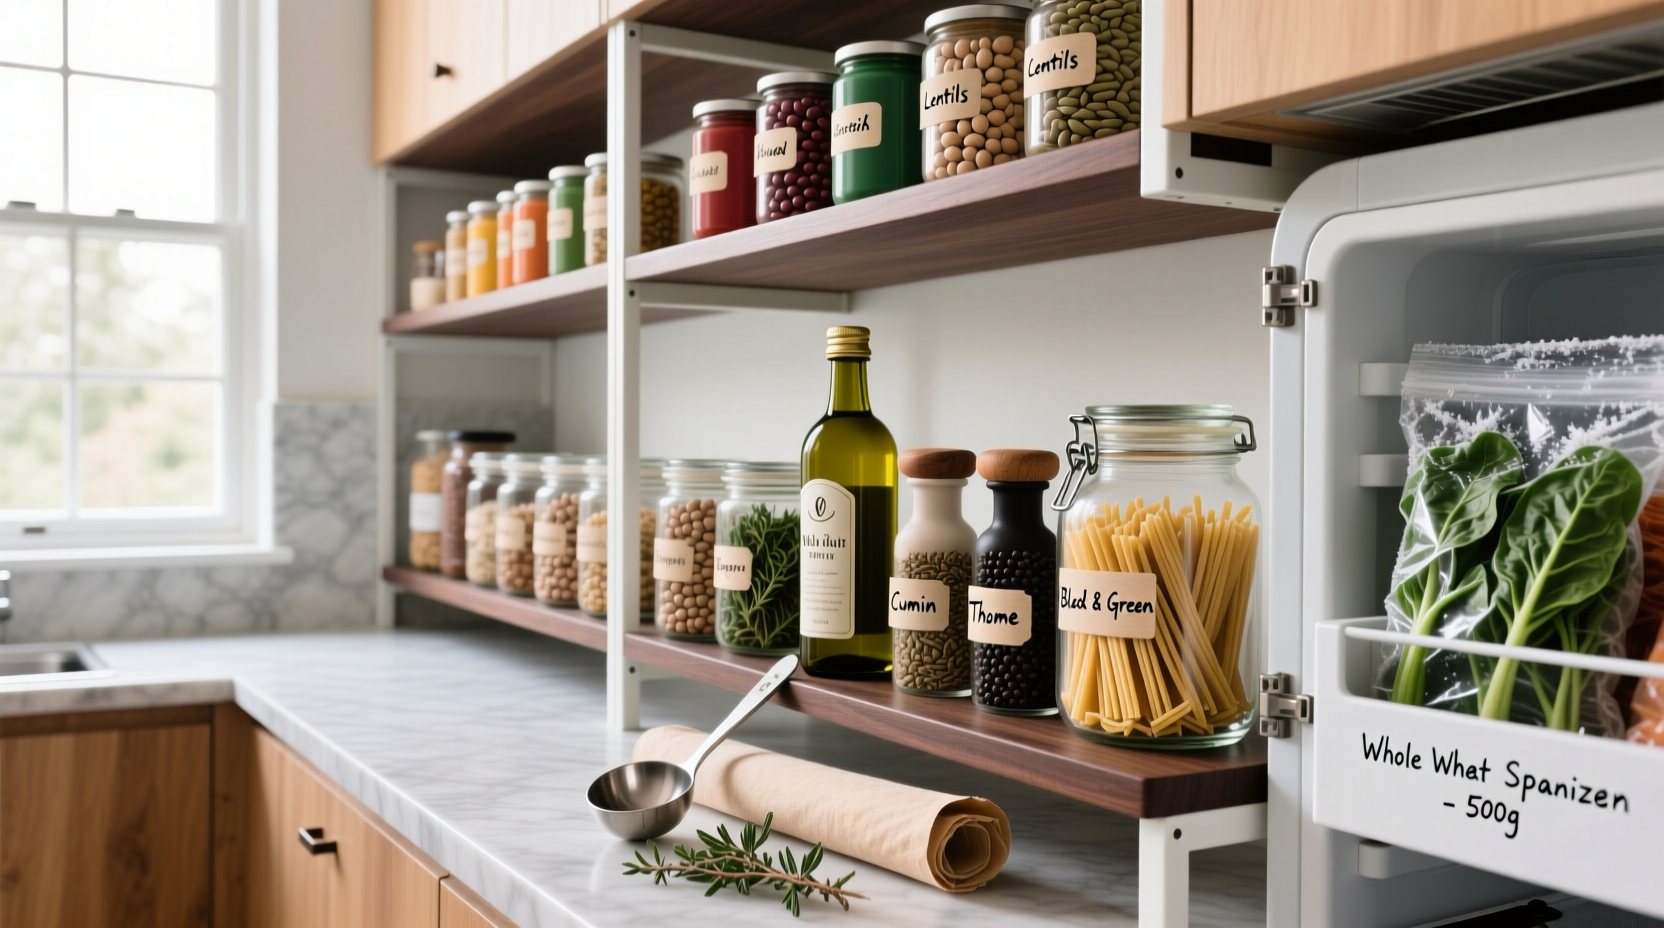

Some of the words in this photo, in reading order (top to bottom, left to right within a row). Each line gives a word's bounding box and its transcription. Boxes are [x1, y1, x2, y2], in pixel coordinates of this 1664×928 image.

[925, 83, 968, 110] Lentils
[891, 591, 936, 613] Cumin
[969, 600, 1019, 625] Thome
[1092, 591, 1101, 611] &
[1107, 591, 1153, 620] Green
[1363, 732, 1422, 770] Whole
[1432, 747, 1491, 782] What
[1505, 760, 1629, 814] Spanizen
[1466, 795, 1519, 839] 500g
